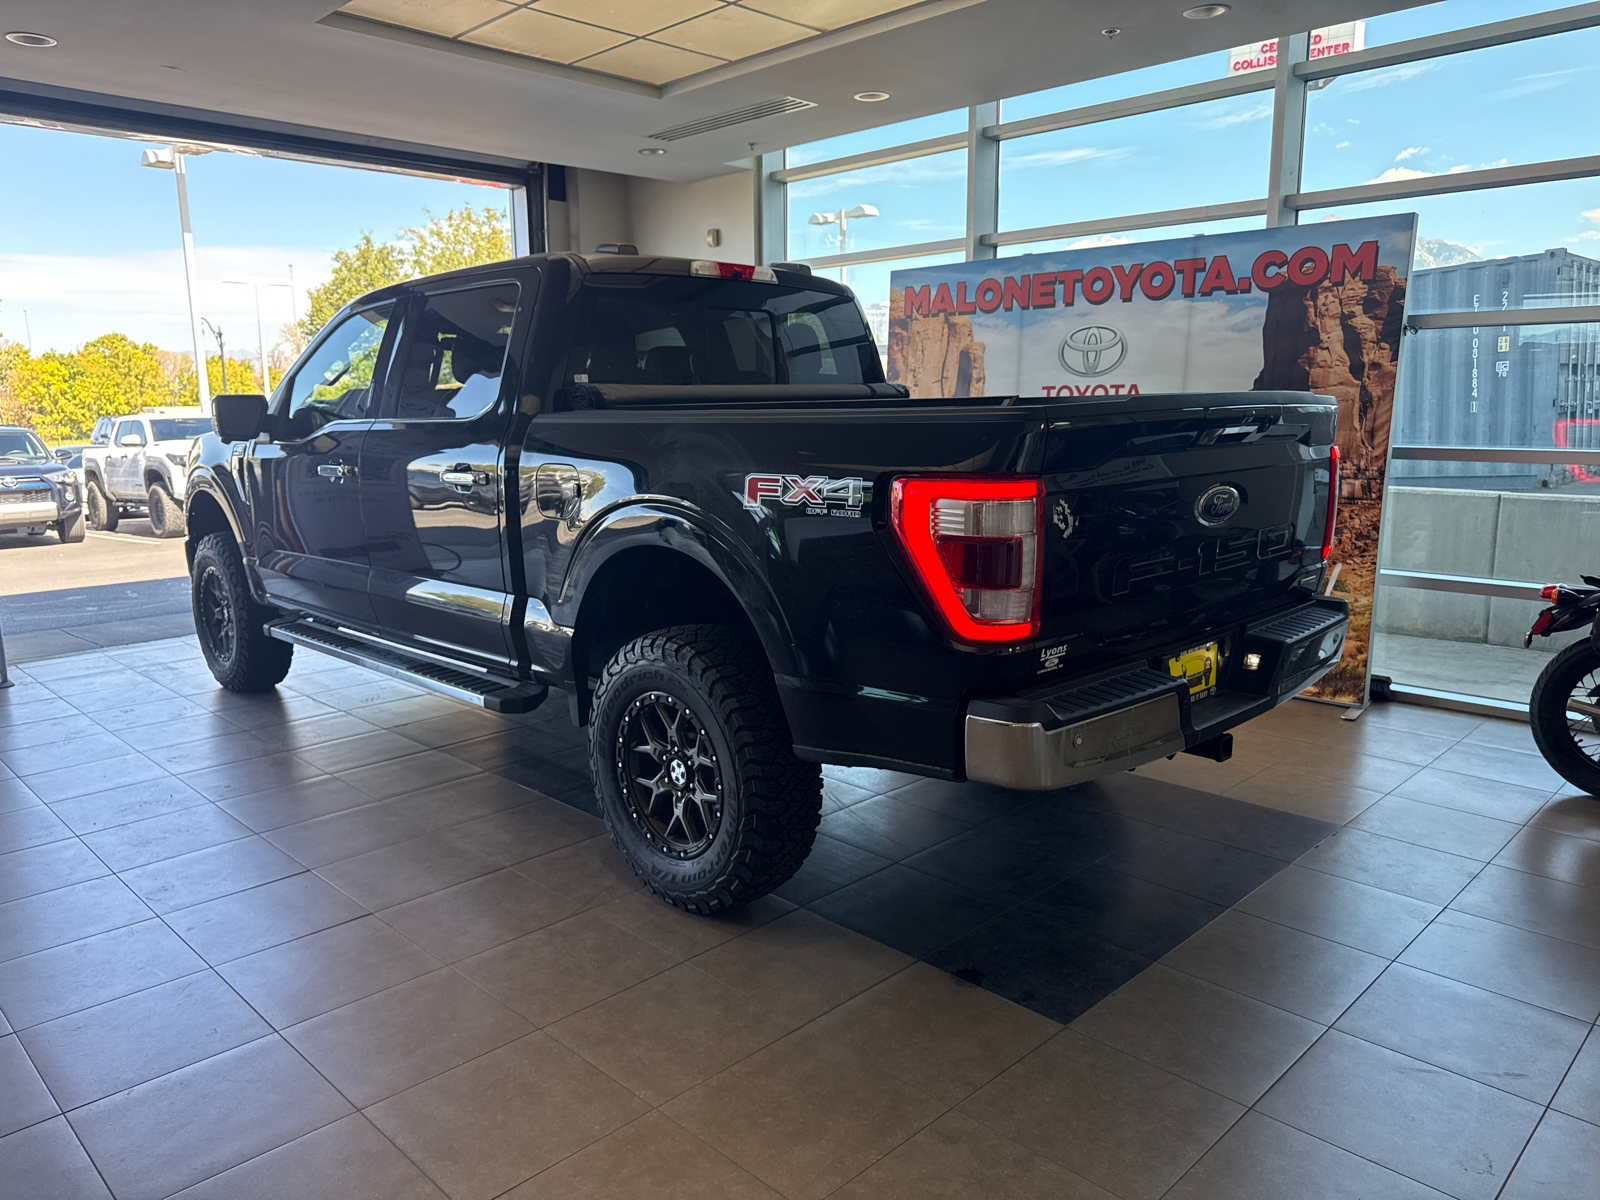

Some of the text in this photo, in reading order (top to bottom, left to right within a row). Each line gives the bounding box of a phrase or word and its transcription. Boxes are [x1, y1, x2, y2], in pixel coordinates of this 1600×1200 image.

[1310, 42, 1350, 59] ENTER
[904, 240, 1379, 319] MALONETOYOTA.COM
[743, 472, 863, 510] FX4
[831, 509, 861, 518] ROAD
[1211, 494, 1234, 514] Ford
[1112, 522, 1294, 597] F-150
[1040, 644, 1068, 660] Lyons
